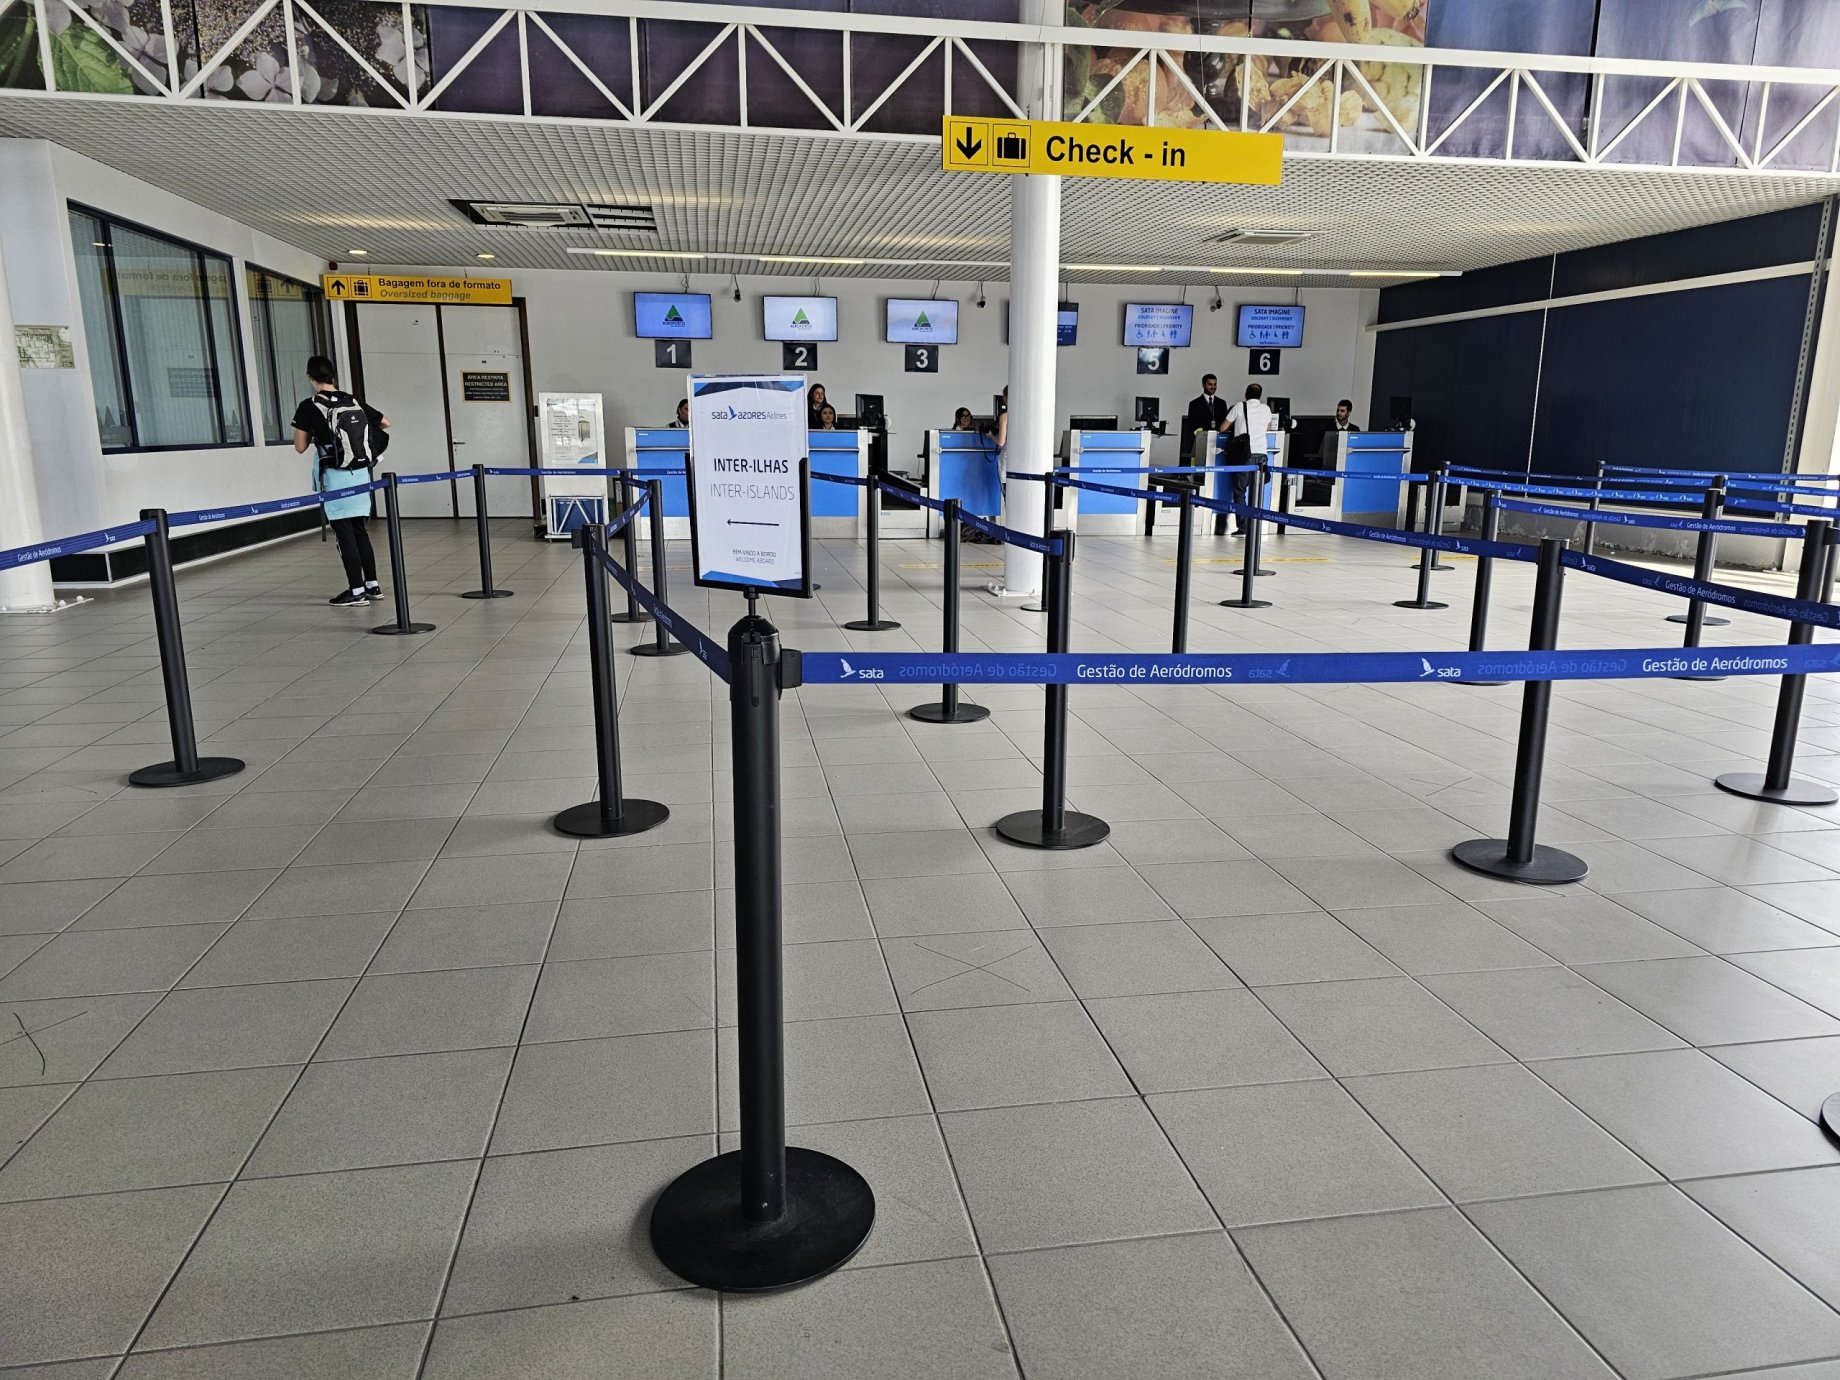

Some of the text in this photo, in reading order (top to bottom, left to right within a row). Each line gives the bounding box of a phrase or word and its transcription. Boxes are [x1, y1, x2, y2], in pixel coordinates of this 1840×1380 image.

[1046, 135, 1134, 165] Check
[1161, 142, 1186, 166] in
[378, 278, 500, 290] Bagagem fora de formato
[380, 290, 471, 300] Oversized baggage
[666, 344, 677, 364] 1
[794, 347, 808, 366] 2
[916, 349, 928, 368] 3
[1148, 353, 1160, 370] 5
[1260, 353, 1270, 371] 6
[712, 411, 728, 419] sata
[714, 458, 788, 474] INTER-ILHAS
[711, 483, 795, 500] INTER-ISLANDS
[1587, 564, 1596, 572] sata
[1665, 580, 1736, 604] Gestão de Aeródromos
[1077, 664, 1232, 678] Gestão de Aeródromos
[1642, 656, 1788, 672] Gestão de Aeródromos
[858, 668, 884, 679] sata
[1437, 667, 1462, 678] sata
